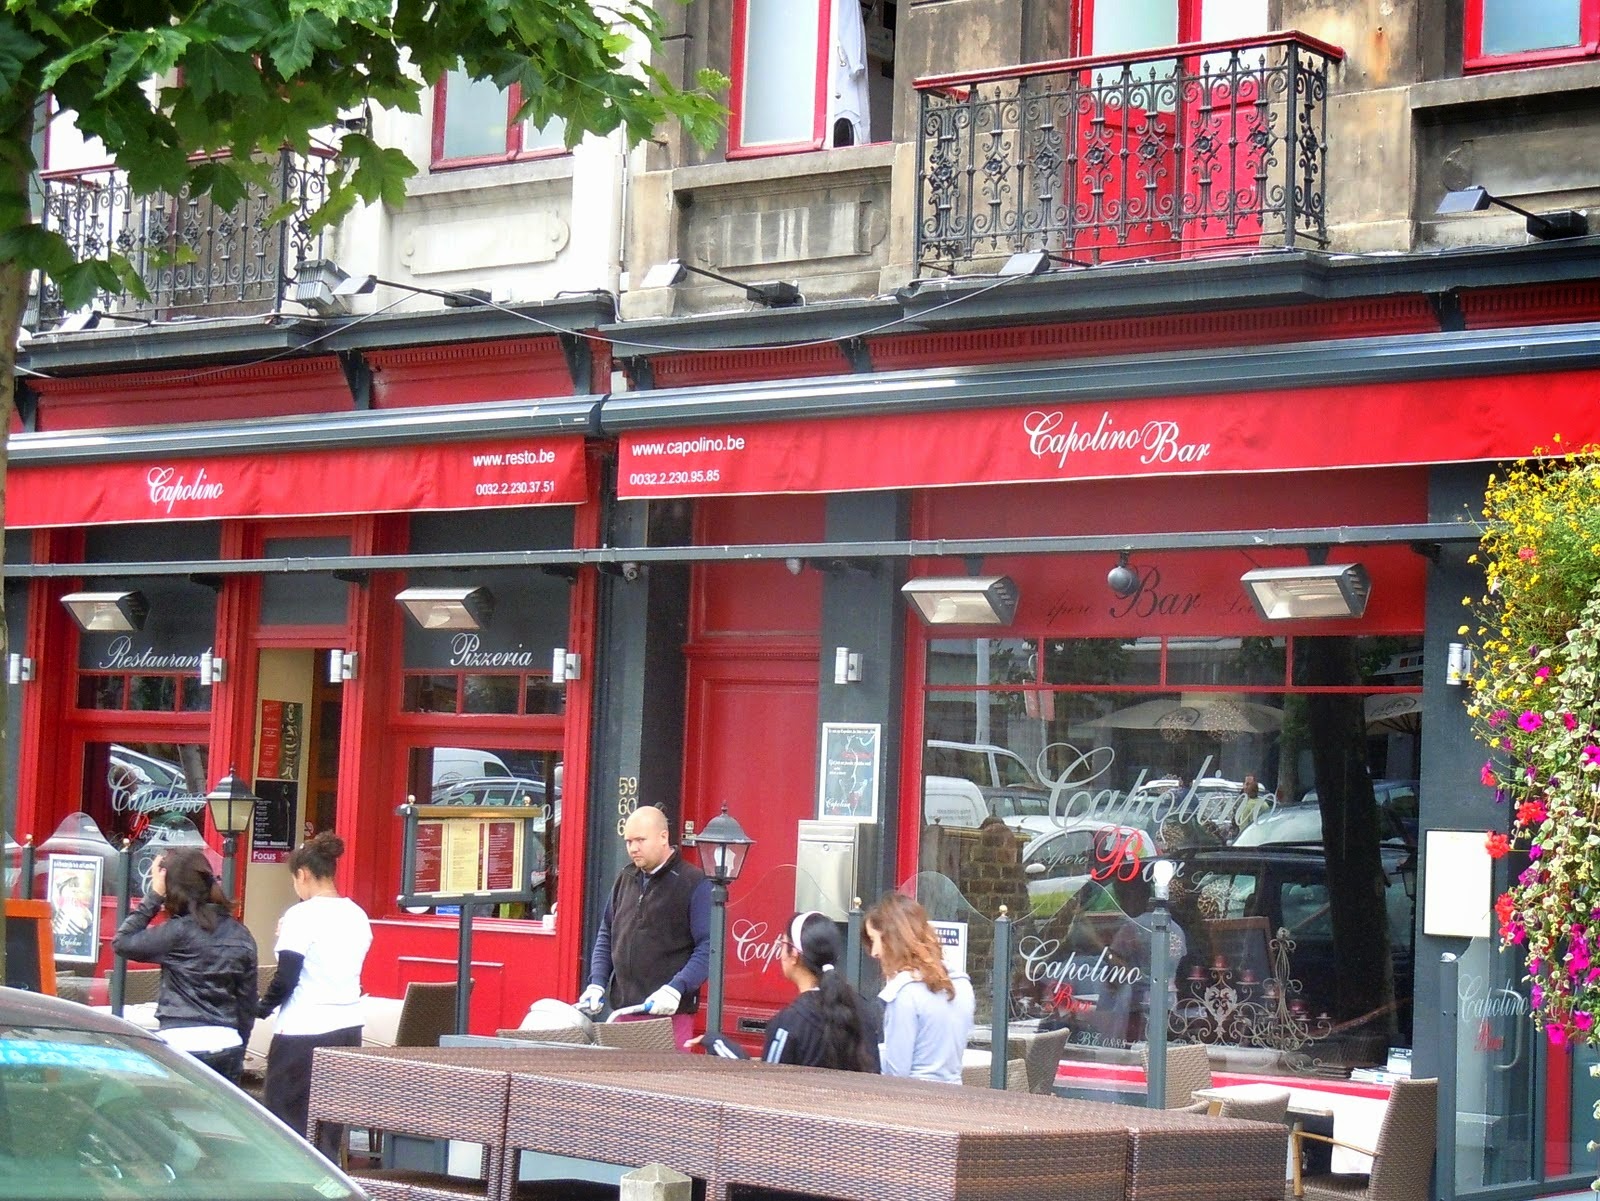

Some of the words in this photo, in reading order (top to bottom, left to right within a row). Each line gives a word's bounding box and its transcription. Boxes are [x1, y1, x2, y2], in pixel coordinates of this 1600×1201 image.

[632, 435, 745, 456] www.capolino.be
[1024, 411, 1141, 468] Capolino
[1140, 421, 1211, 464] Bar
[473, 449, 555, 466] www.resto.be
[629, 469, 720, 485] 0032.2.230.95.85
[147, 467, 224, 513] Capolino
[476, 481, 554, 495] 0032.2.230.37.51
[1109, 563, 1201, 618] Bar
[450, 632, 533, 666] Pizzeria
[618, 776, 637, 795] 59
[1036, 742, 1283, 850] Capolino
[618, 797, 637, 815] 60
[253, 851, 277, 861] Focus
[1019, 935, 1142, 994] Capolino
